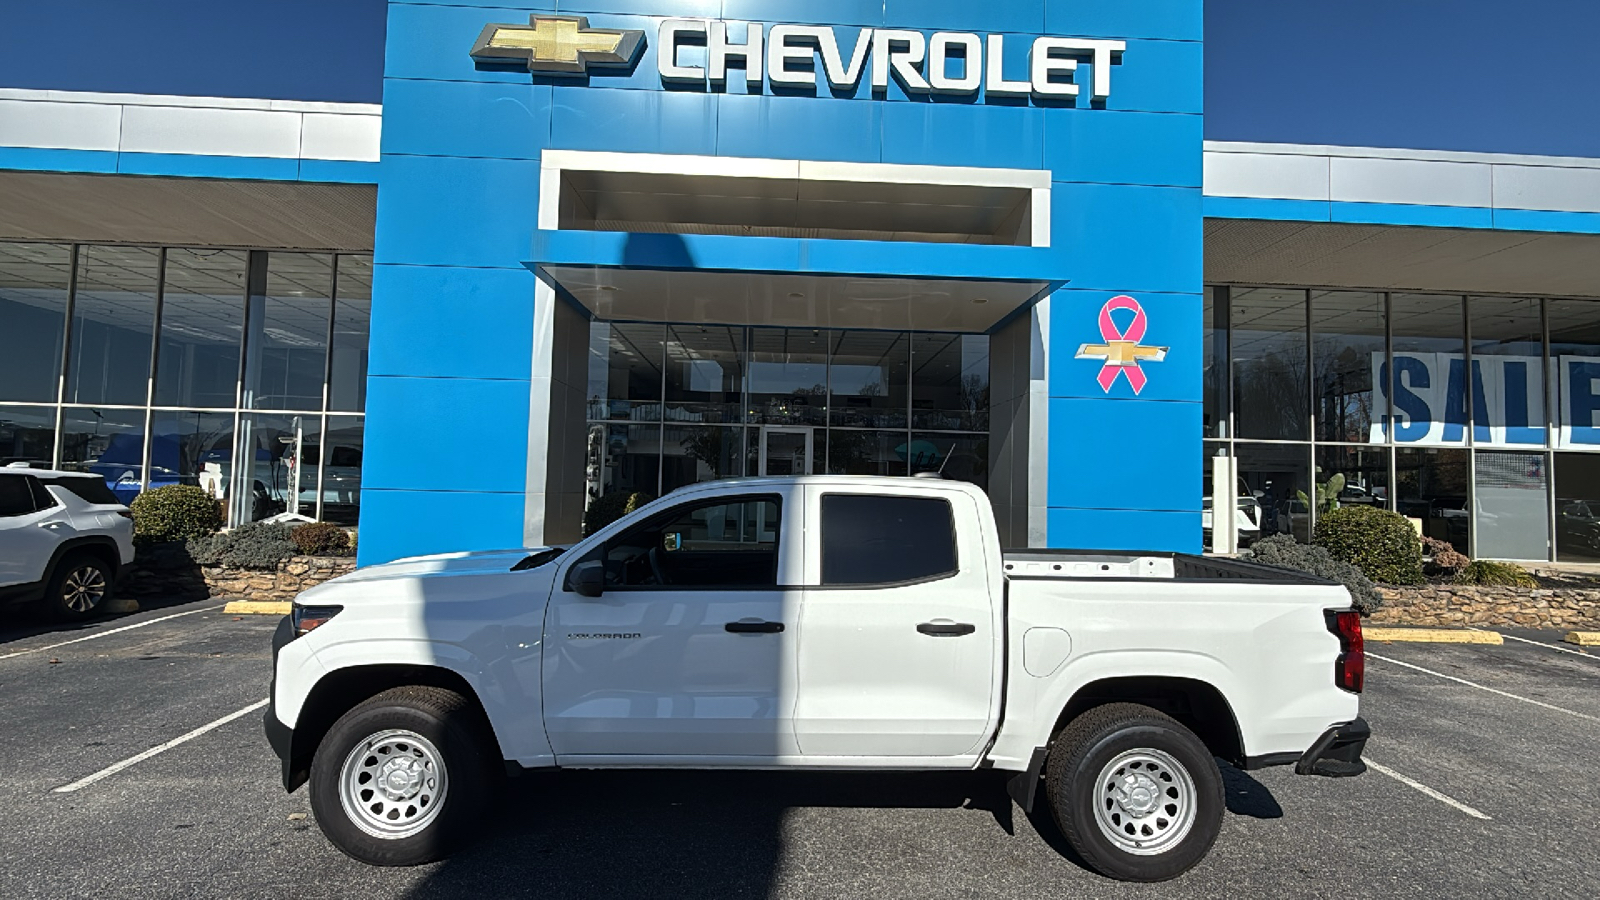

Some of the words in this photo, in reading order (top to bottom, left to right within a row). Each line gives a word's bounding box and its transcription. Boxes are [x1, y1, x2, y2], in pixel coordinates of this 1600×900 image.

[659, 20, 1126, 106] CHEVROLET
[1380, 356, 1600, 444] SALE
[567, 632, 642, 640] COLORADO
